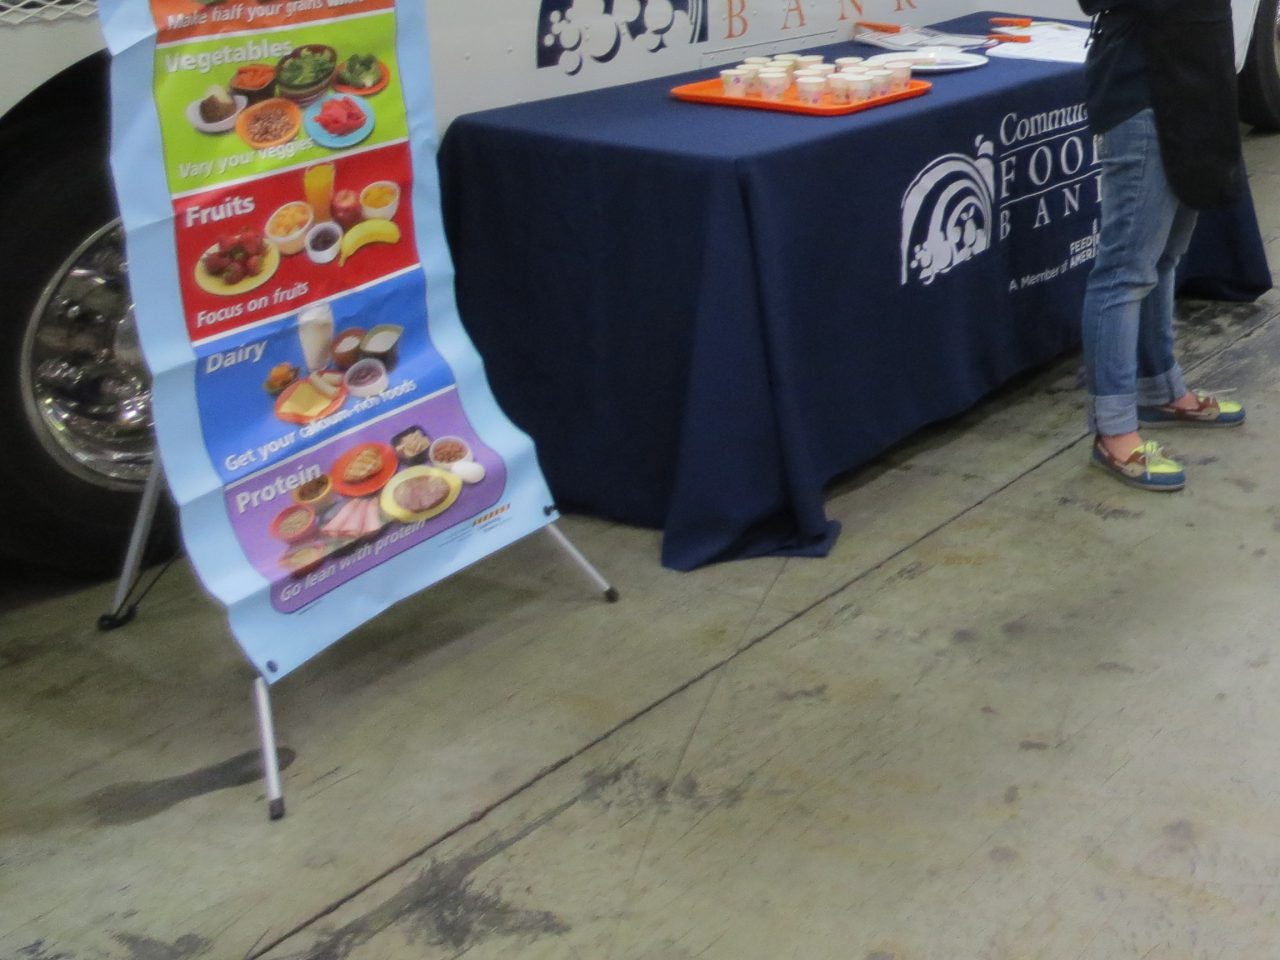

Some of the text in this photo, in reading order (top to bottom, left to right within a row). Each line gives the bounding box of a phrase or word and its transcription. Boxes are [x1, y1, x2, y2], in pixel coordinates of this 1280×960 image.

[167, 10, 208, 30] Make
[212, 4, 242, 22] half
[247, 5, 283, 22] your
[164, 39, 294, 73] Vegetables
[178, 138, 314, 179] Vary your veggies
[185, 193, 256, 228] Fruits
[1008, 278, 1019, 292] A
[1021, 266, 1061, 288] Member
[196, 280, 310, 327] Focus on fruits
[205, 340, 268, 374] Dairy
[225, 448, 254, 472] Get
[258, 432, 297, 461] your
[381, 378, 418, 403] foods
[235, 462, 323, 514] Protein
[279, 582, 302, 603] Go
[304, 563, 336, 587] lean
[339, 544, 373, 572] with
[374, 517, 427, 556] protein
